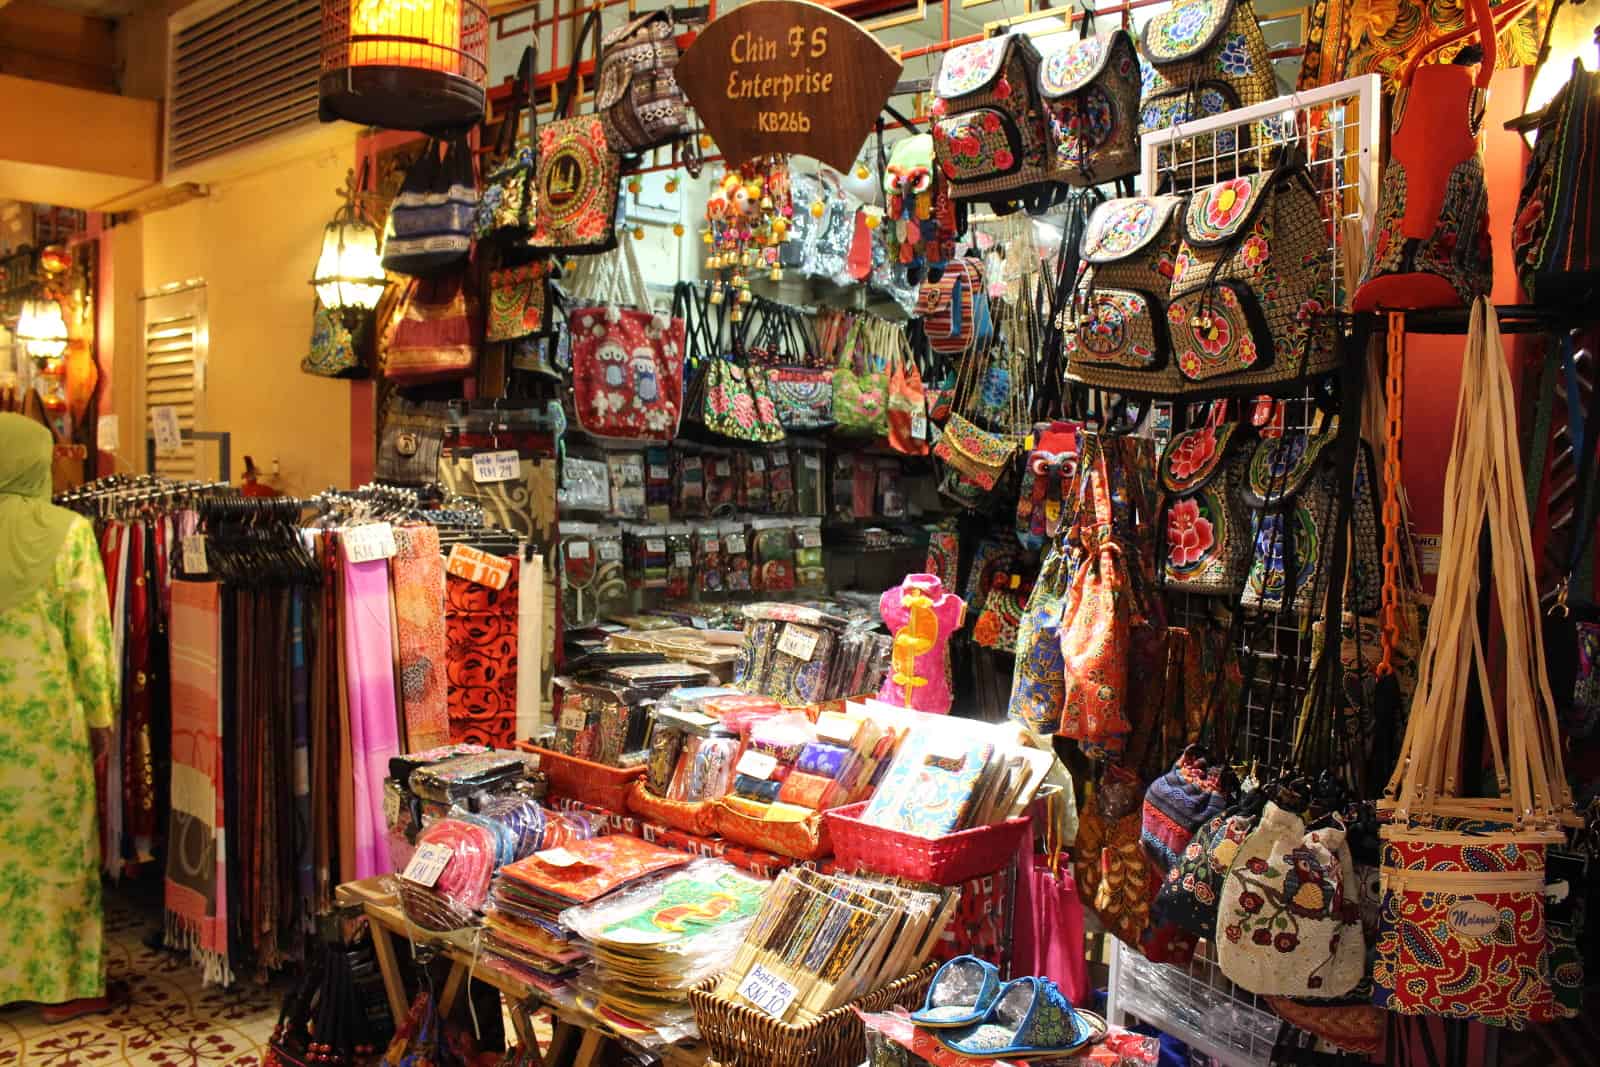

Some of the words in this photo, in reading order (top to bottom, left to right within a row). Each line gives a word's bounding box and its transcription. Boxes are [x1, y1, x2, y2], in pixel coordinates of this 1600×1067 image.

[730, 32, 777, 64] Chin
[727, 68, 833, 102] Enterprise
[758, 111, 811, 132] KB26b
[479, 466, 496, 478] RM
[449, 557, 477, 579] RM
[480, 566, 500, 588] 10
[1449, 910, 1496, 928] Malaysia
[751, 965, 777, 988] Batik
[743, 981, 768, 1004] RM
[763, 994, 785, 1014] 10
